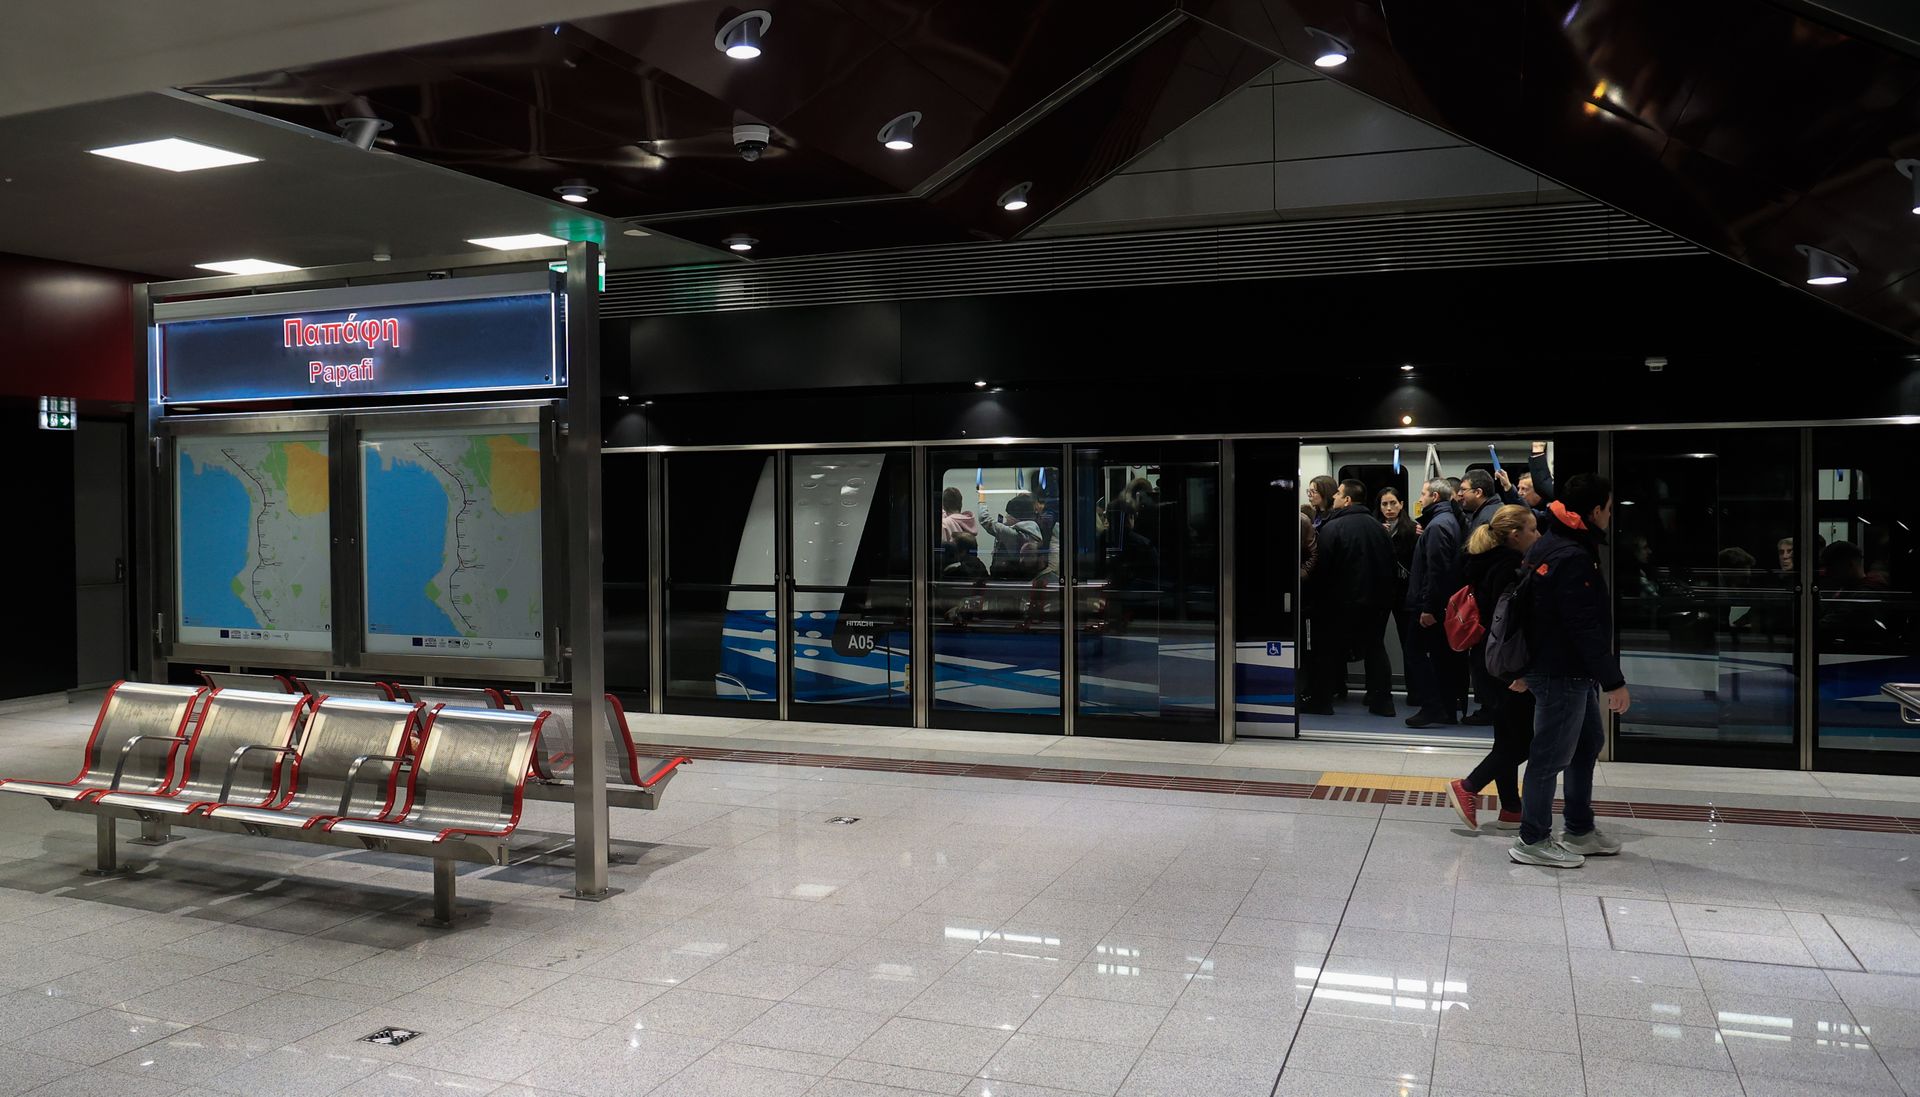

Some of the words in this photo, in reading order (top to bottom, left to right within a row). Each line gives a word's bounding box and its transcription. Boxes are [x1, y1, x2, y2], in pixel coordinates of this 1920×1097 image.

[284, 313, 399, 348] Παπάφη
[309, 358, 373, 387] Papafi
[848, 634, 874, 650] A05
